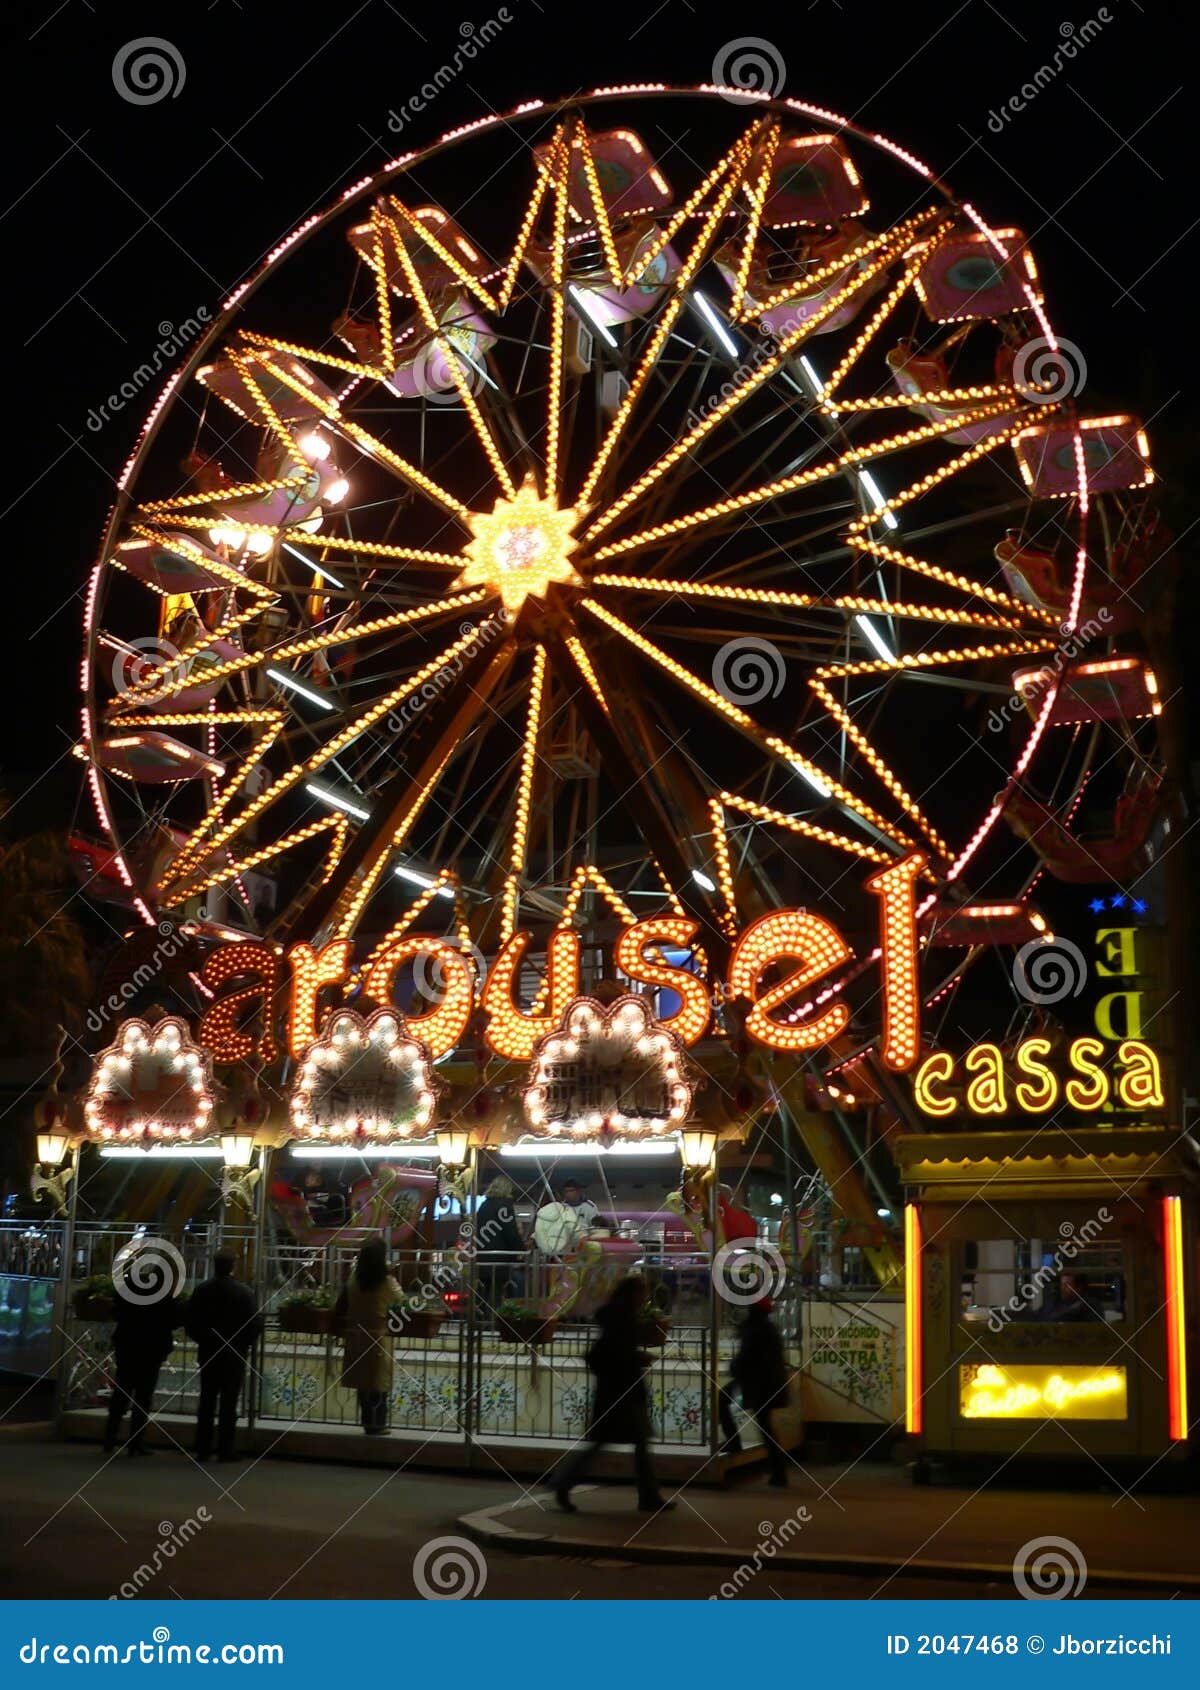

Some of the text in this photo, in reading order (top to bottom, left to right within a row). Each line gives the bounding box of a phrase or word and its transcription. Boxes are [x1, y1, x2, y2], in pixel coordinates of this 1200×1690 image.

[199, 853, 926, 1071] arousel
[914, 1037, 1165, 1117] cassa
[812, 1350, 878, 1365] GIOSTRA
